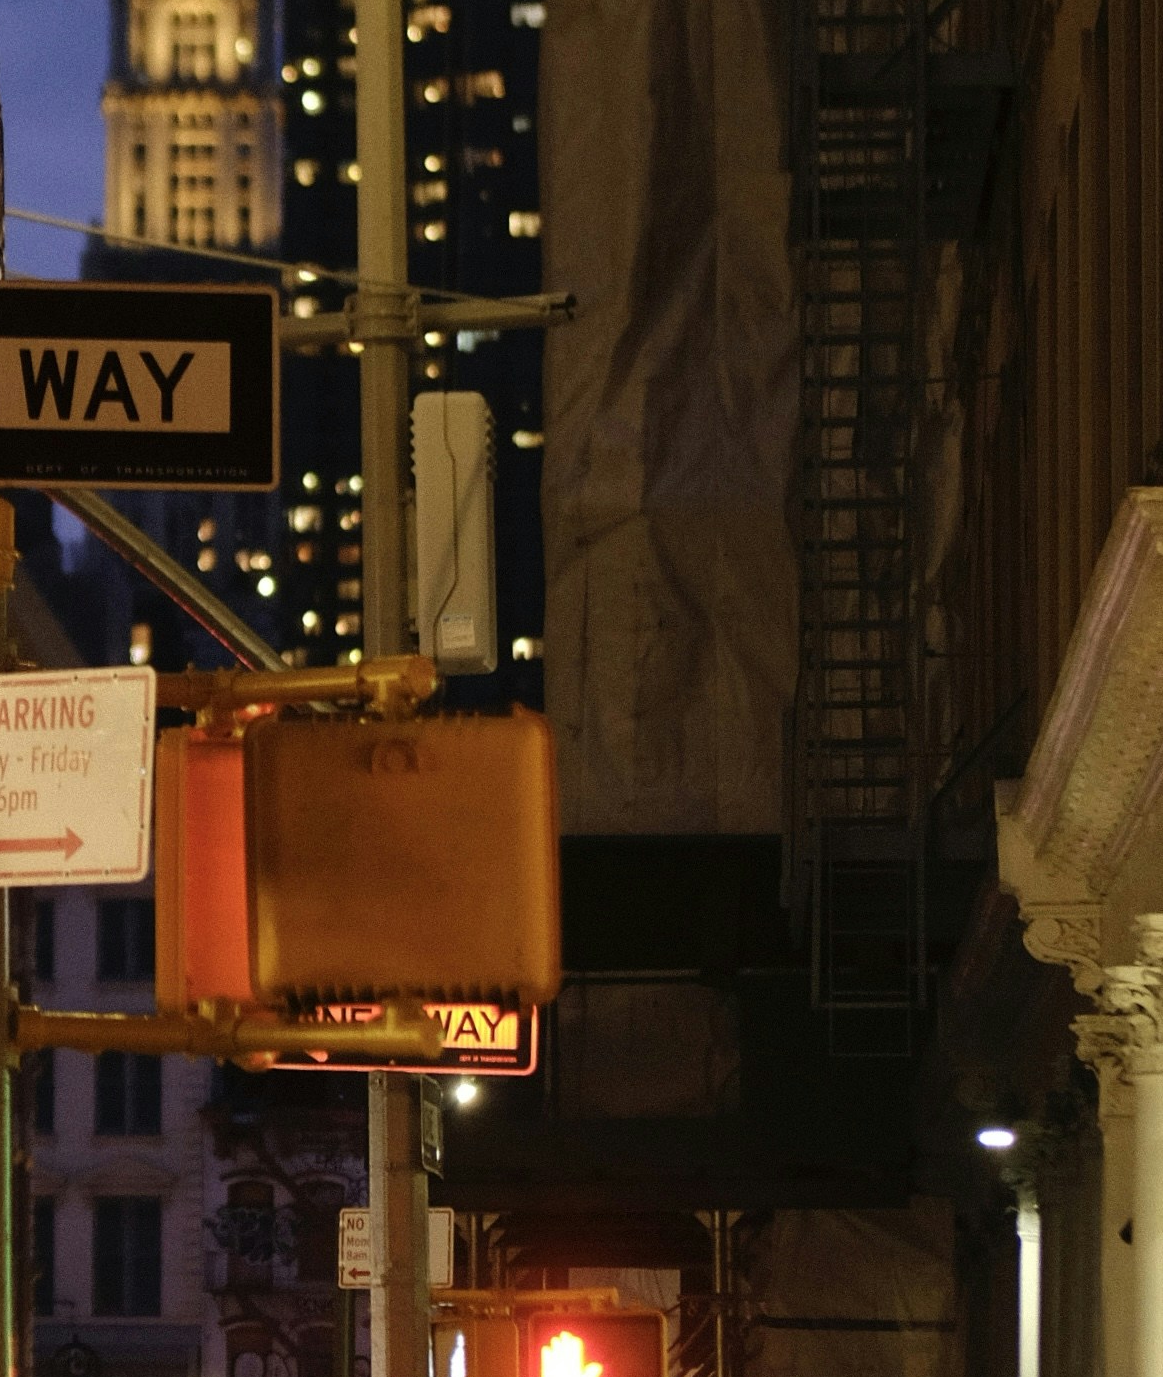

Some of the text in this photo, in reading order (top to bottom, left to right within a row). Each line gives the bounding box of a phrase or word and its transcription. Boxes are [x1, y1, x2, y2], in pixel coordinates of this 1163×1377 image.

[19, 348, 195, 422] WAY
[25, 464, 249, 477] DEPT OF TRANSPORTATION
[31, 746, 92, 777] Friday
[346, 1217, 365, 1231] NO
[346, 1250, 367, 1261] 8am
